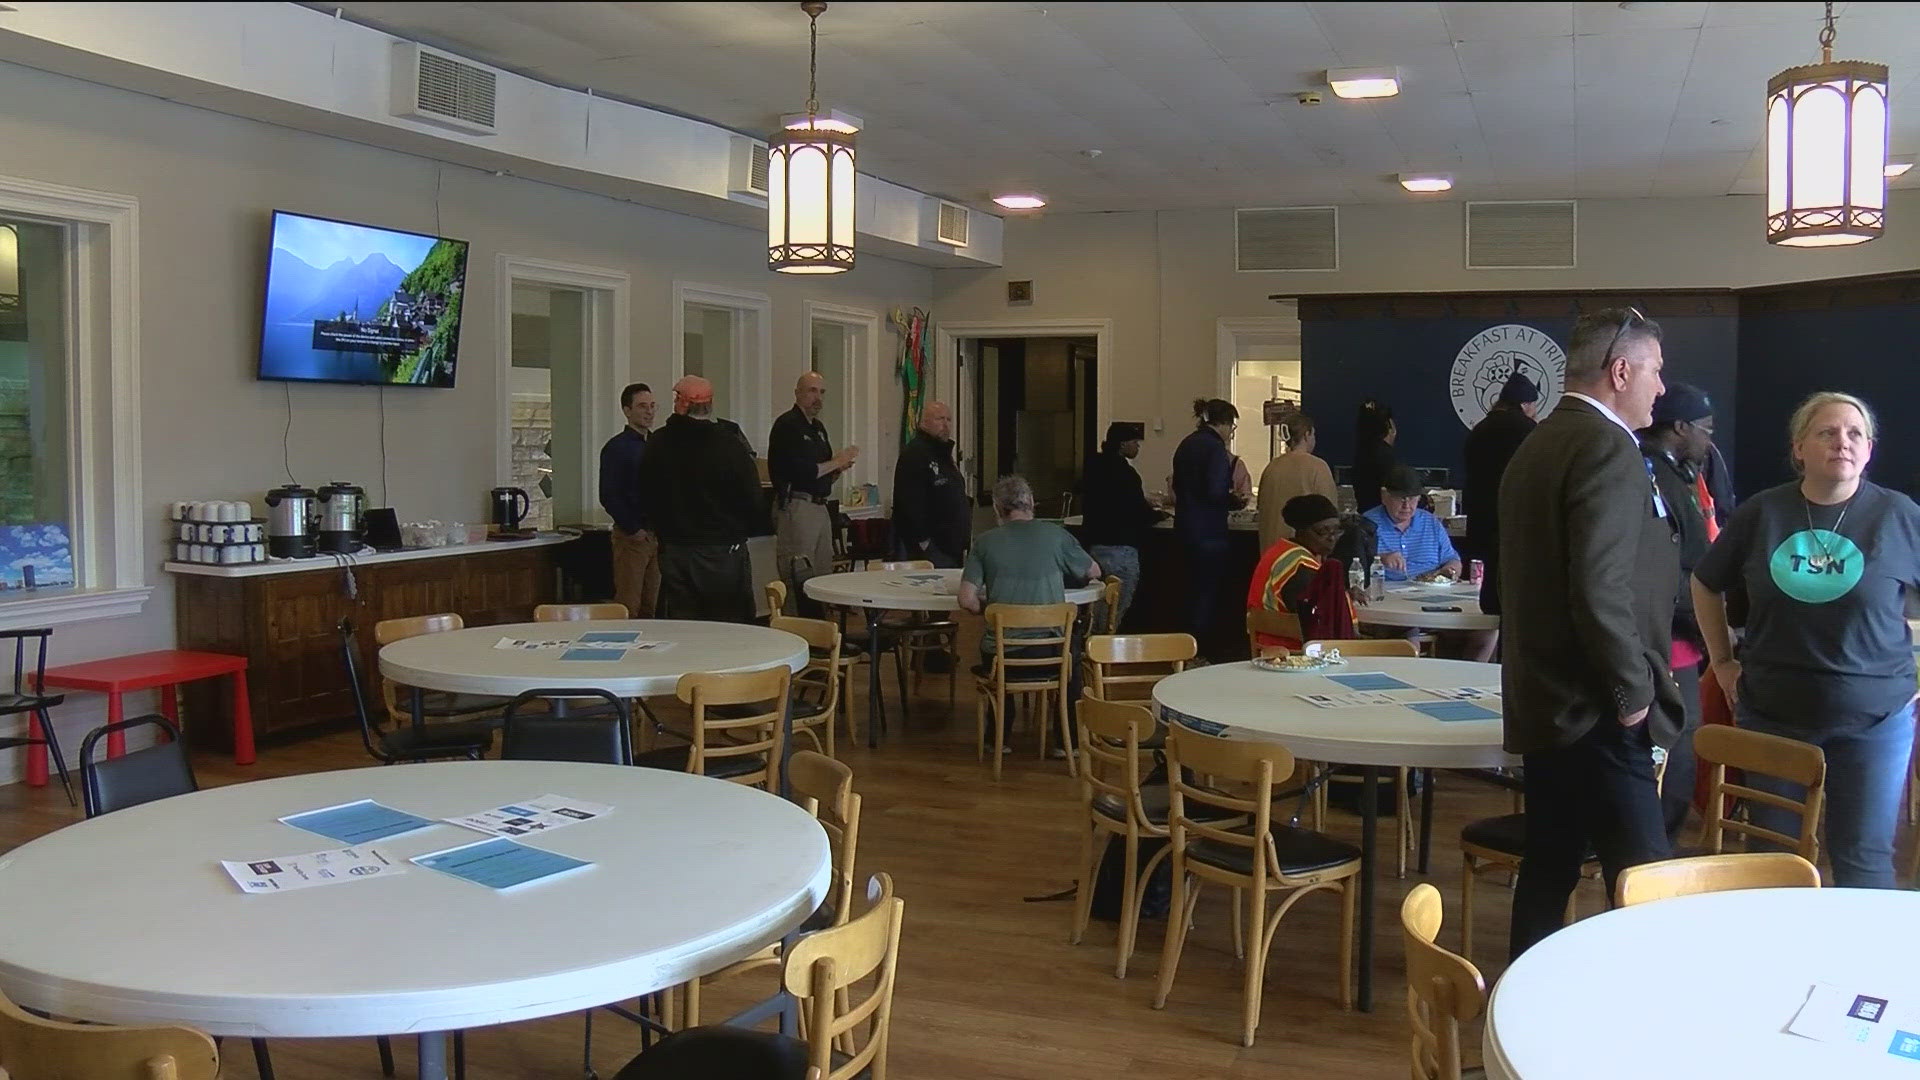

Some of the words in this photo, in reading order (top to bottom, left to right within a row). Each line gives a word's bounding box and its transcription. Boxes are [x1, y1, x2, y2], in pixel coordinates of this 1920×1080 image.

[1452, 327, 1509, 398] BREAKFAST
[1515, 328, 1537, 343] AT
[1790, 554, 1846, 575] TSN
